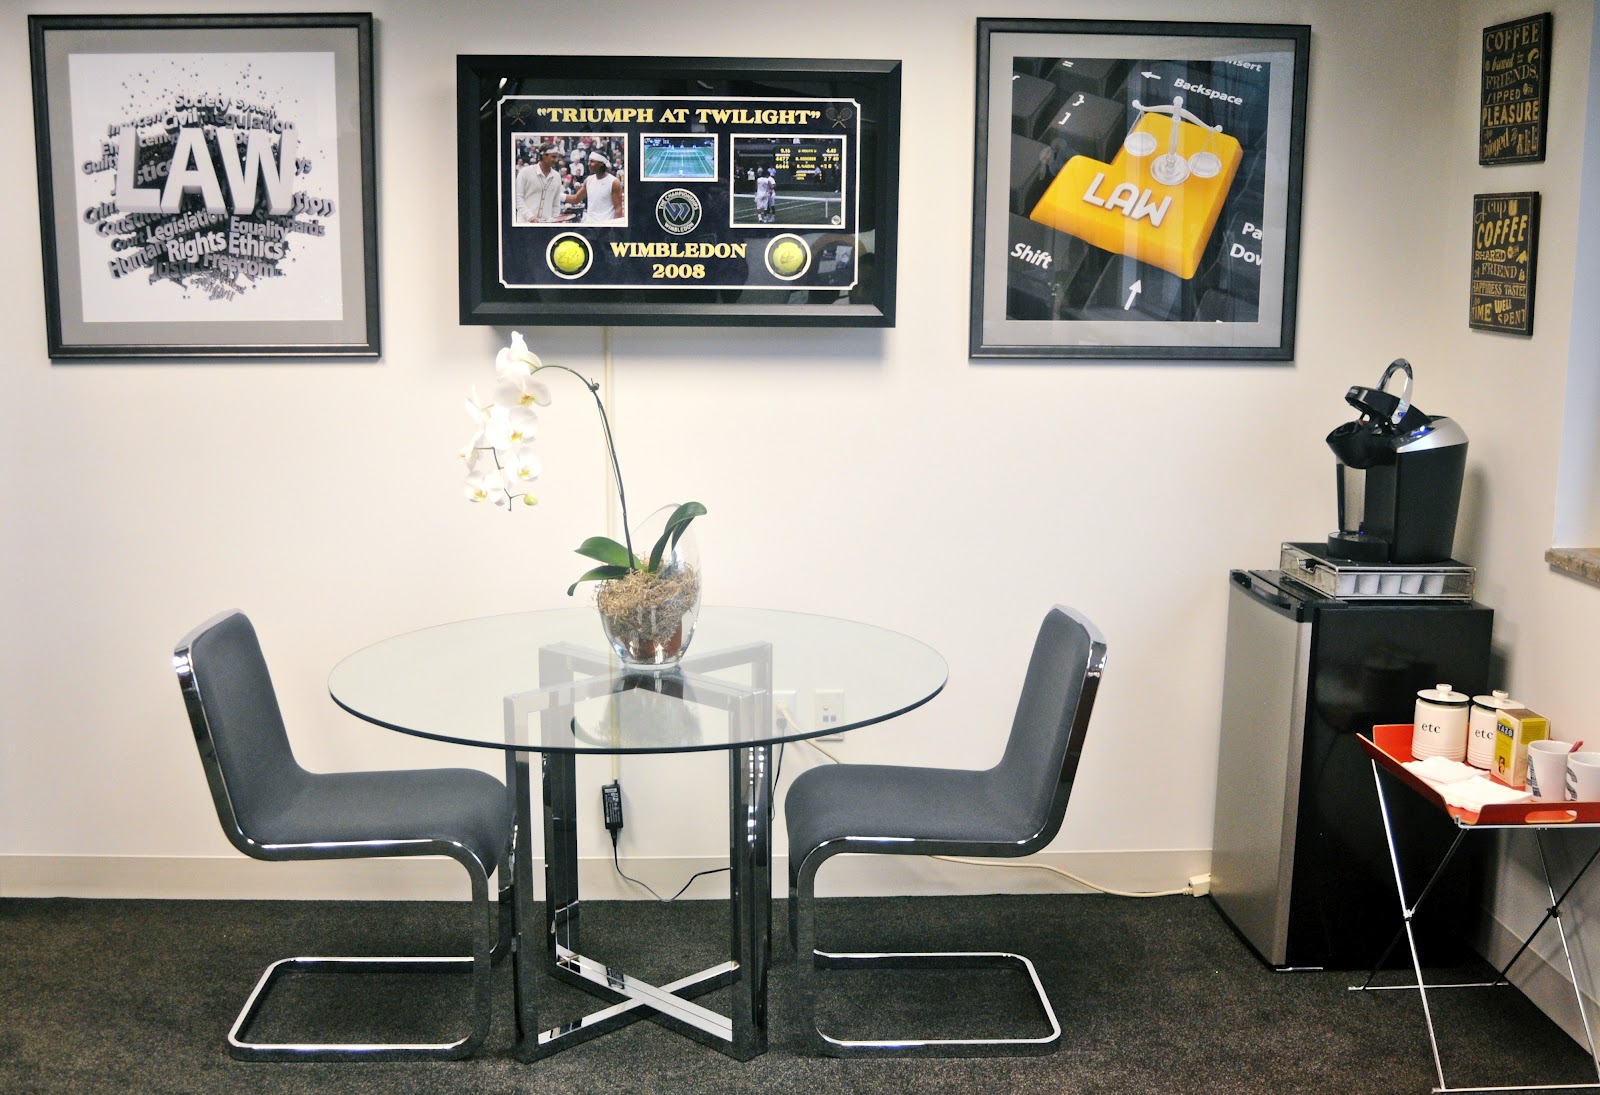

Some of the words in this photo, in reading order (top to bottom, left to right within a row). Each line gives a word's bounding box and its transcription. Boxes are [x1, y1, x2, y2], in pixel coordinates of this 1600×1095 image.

[1485, 22, 1541, 53] COFFEE
[175, 95, 231, 116] Society
[1173, 78, 1243, 106] Backspace
[659, 108, 689, 123] AT
[1482, 100, 1539, 127] PLEASURE
[115, 126, 298, 214] LAW
[1082, 172, 1173, 228] LAW
[146, 207, 228, 243] Legislation
[230, 216, 289, 243] Equality
[664, 221, 694, 233] WIMBLEDON
[1476, 214, 1528, 250] COFFEE
[108, 240, 168, 279] Human
[166, 231, 228, 264] Rights
[229, 232, 284, 261] Ethics
[610, 242, 748, 259] WIMBLEDON
[1010, 242, 1053, 269] Shift
[203, 252, 275, 278] Freedom
[652, 263, 706, 279] 2008
[1481, 262, 1518, 279] FRIEND
[1421, 722, 1441, 735] etc
[1474, 729, 1494, 740] etc
